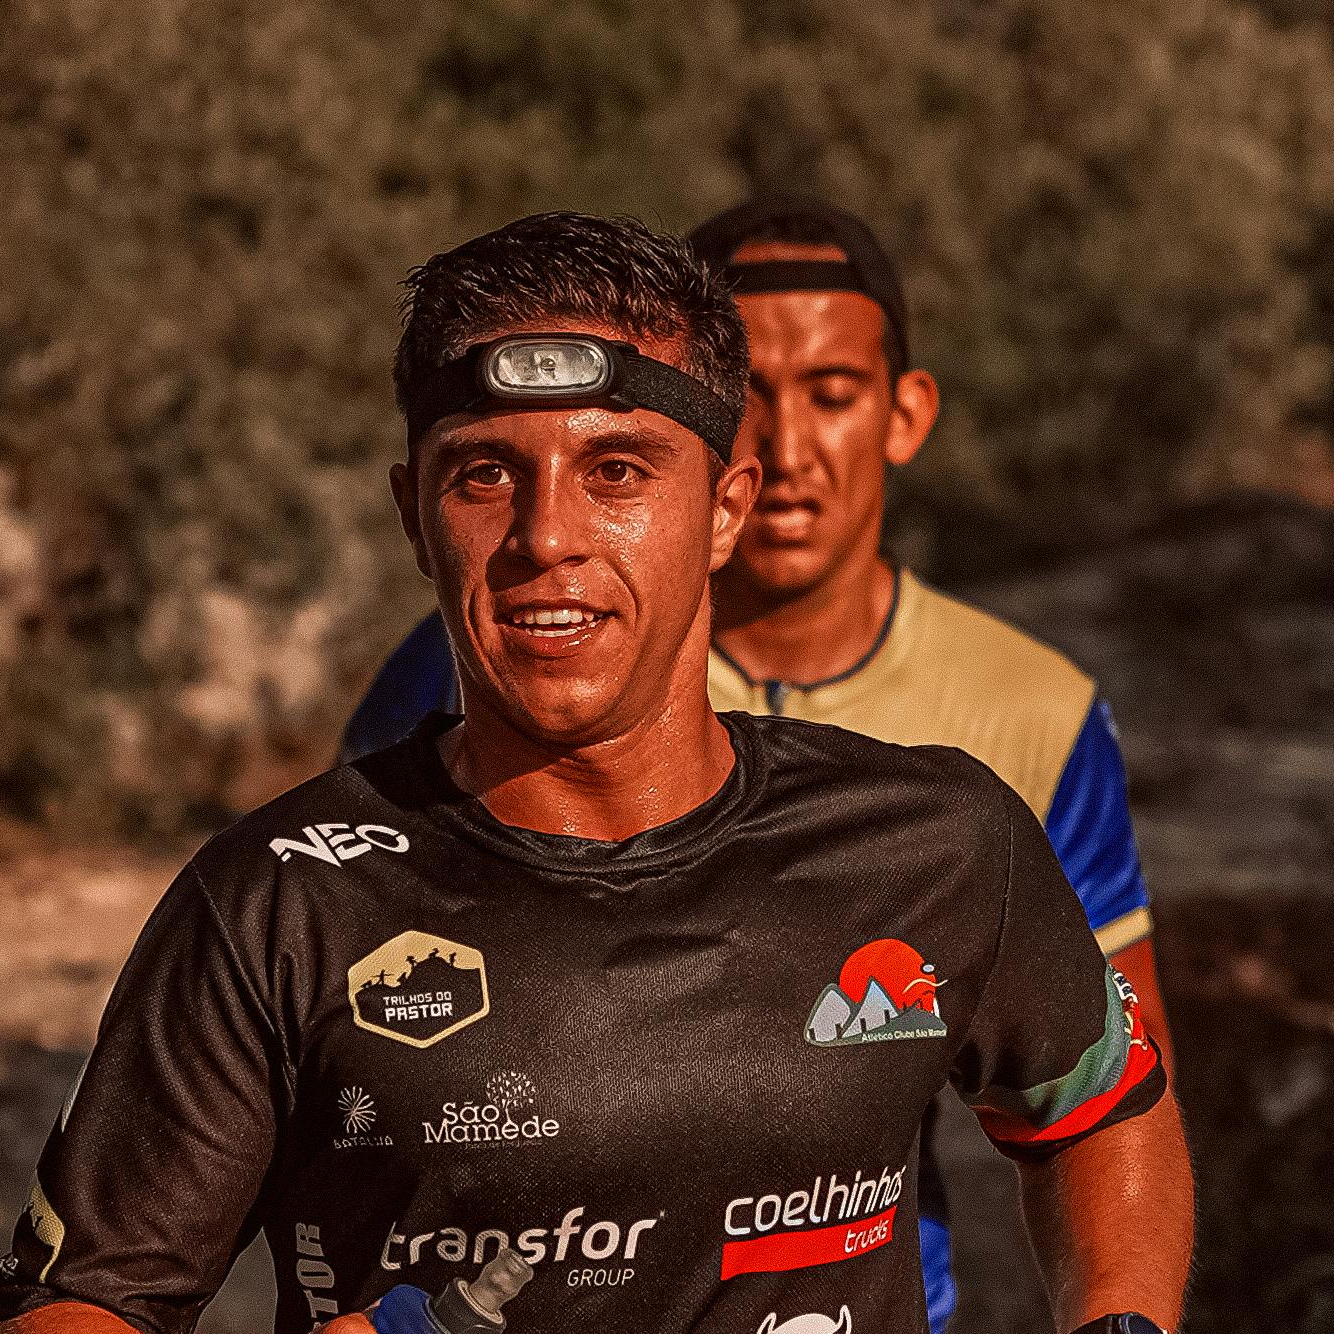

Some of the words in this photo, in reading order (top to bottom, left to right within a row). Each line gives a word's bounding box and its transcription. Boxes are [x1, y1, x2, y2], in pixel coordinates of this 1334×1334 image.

[269, 823, 410, 869] NEO
[383, 993, 433, 1006] TRILHOS
[385, 1002, 454, 1022] PASTOR
[442, 1101, 500, 1125] São
[422, 1116, 560, 1144] Mamede
[381, 1206, 658, 1270] transfor
[844, 1219, 889, 1253] trucks
[568, 1268, 635, 1287] GROUP
